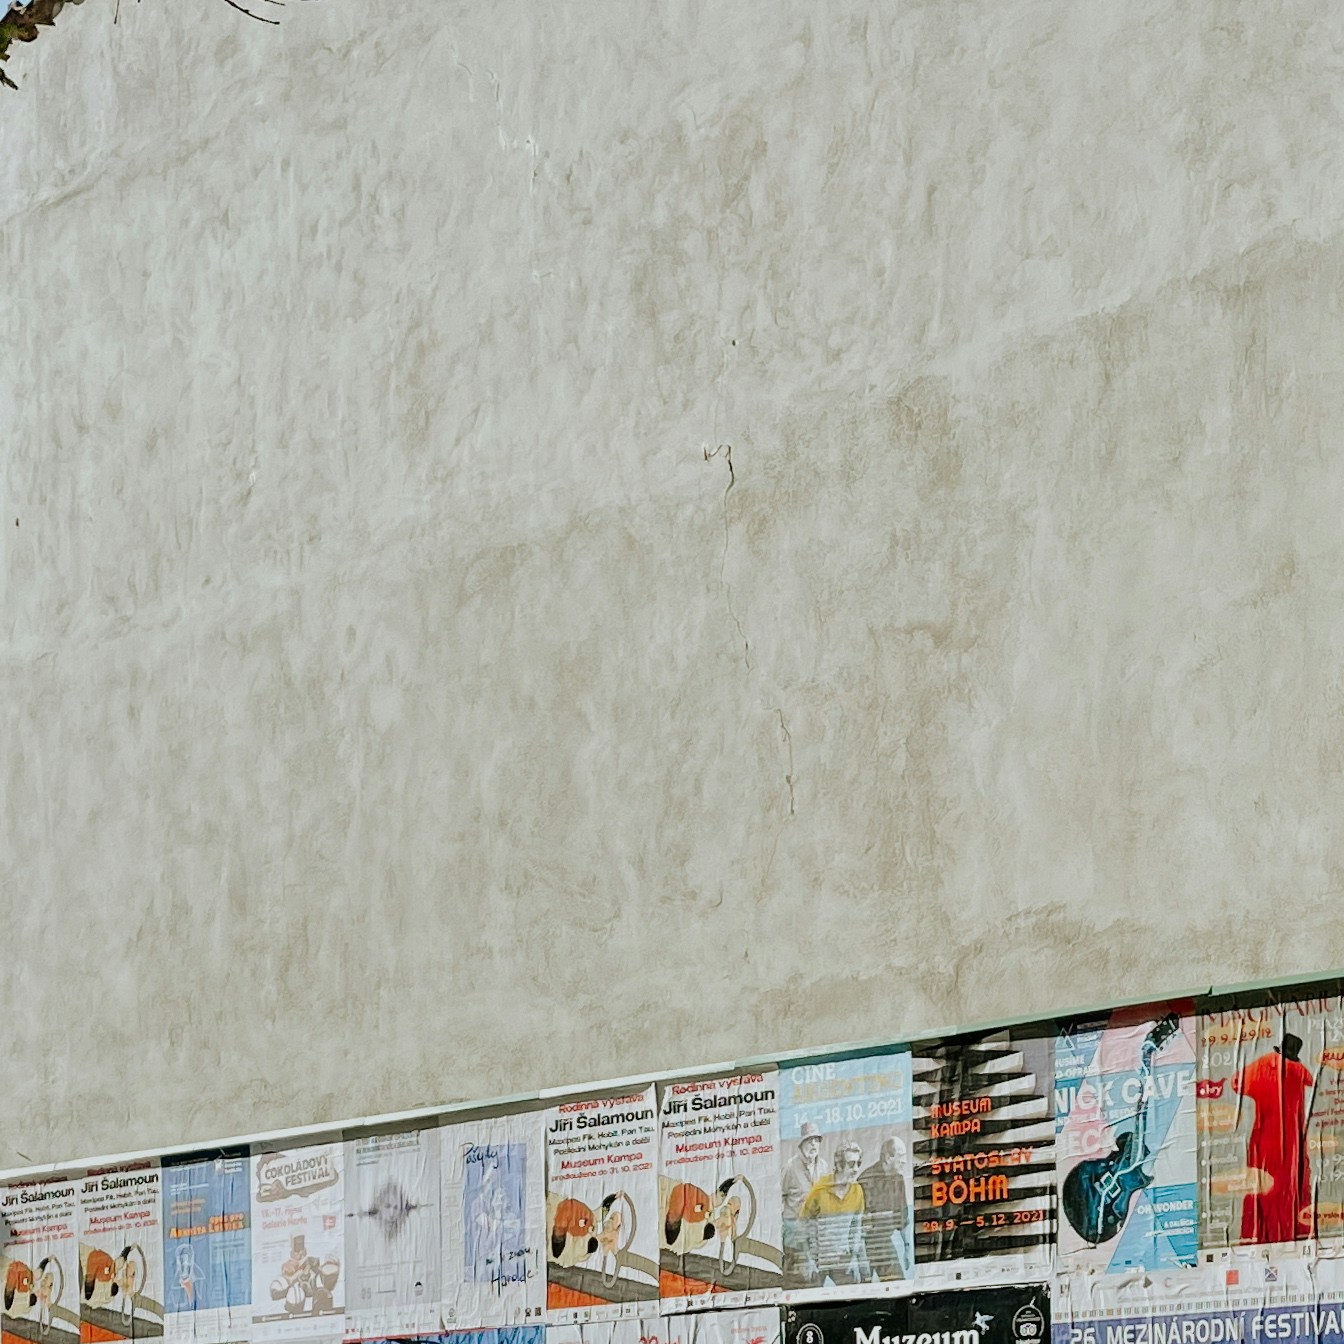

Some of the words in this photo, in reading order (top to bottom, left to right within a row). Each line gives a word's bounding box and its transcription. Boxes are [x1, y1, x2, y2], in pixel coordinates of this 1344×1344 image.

[792, 1064, 836, 1085] CINE
[1055, 1080, 1115, 1114] NICK
[1121, 1070, 1195, 1104] CAVE
[1206, 1082, 1223, 1096] hry
[663, 1100, 688, 1115] Jiří
[692, 1090, 775, 1111] Šalamoun
[868, 1098, 903, 1117] 2021
[930, 1096, 992, 1118] MUSEUM
[549, 1117, 573, 1133] Jiří
[576, 1108, 654, 1129] Šalamoun
[930, 1119, 981, 1138] KAMPA
[675, 1140, 721, 1153] Museum
[723, 1134, 763, 1147] Kampa
[561, 1157, 604, 1170] Museum
[607, 1151, 643, 1163] Kampa
[931, 1146, 1033, 1175] SVATOSLAV
[101, 1174, 158, 1191] Šalamoun
[285, 1168, 330, 1187] FESTIVAL
[20, 1187, 74, 1204] Šalamoun
[932, 1175, 1008, 1207] BÖHM
[1153, 1200, 1194, 1212] WONDER
[1013, 1209, 1044, 1223] 2021
